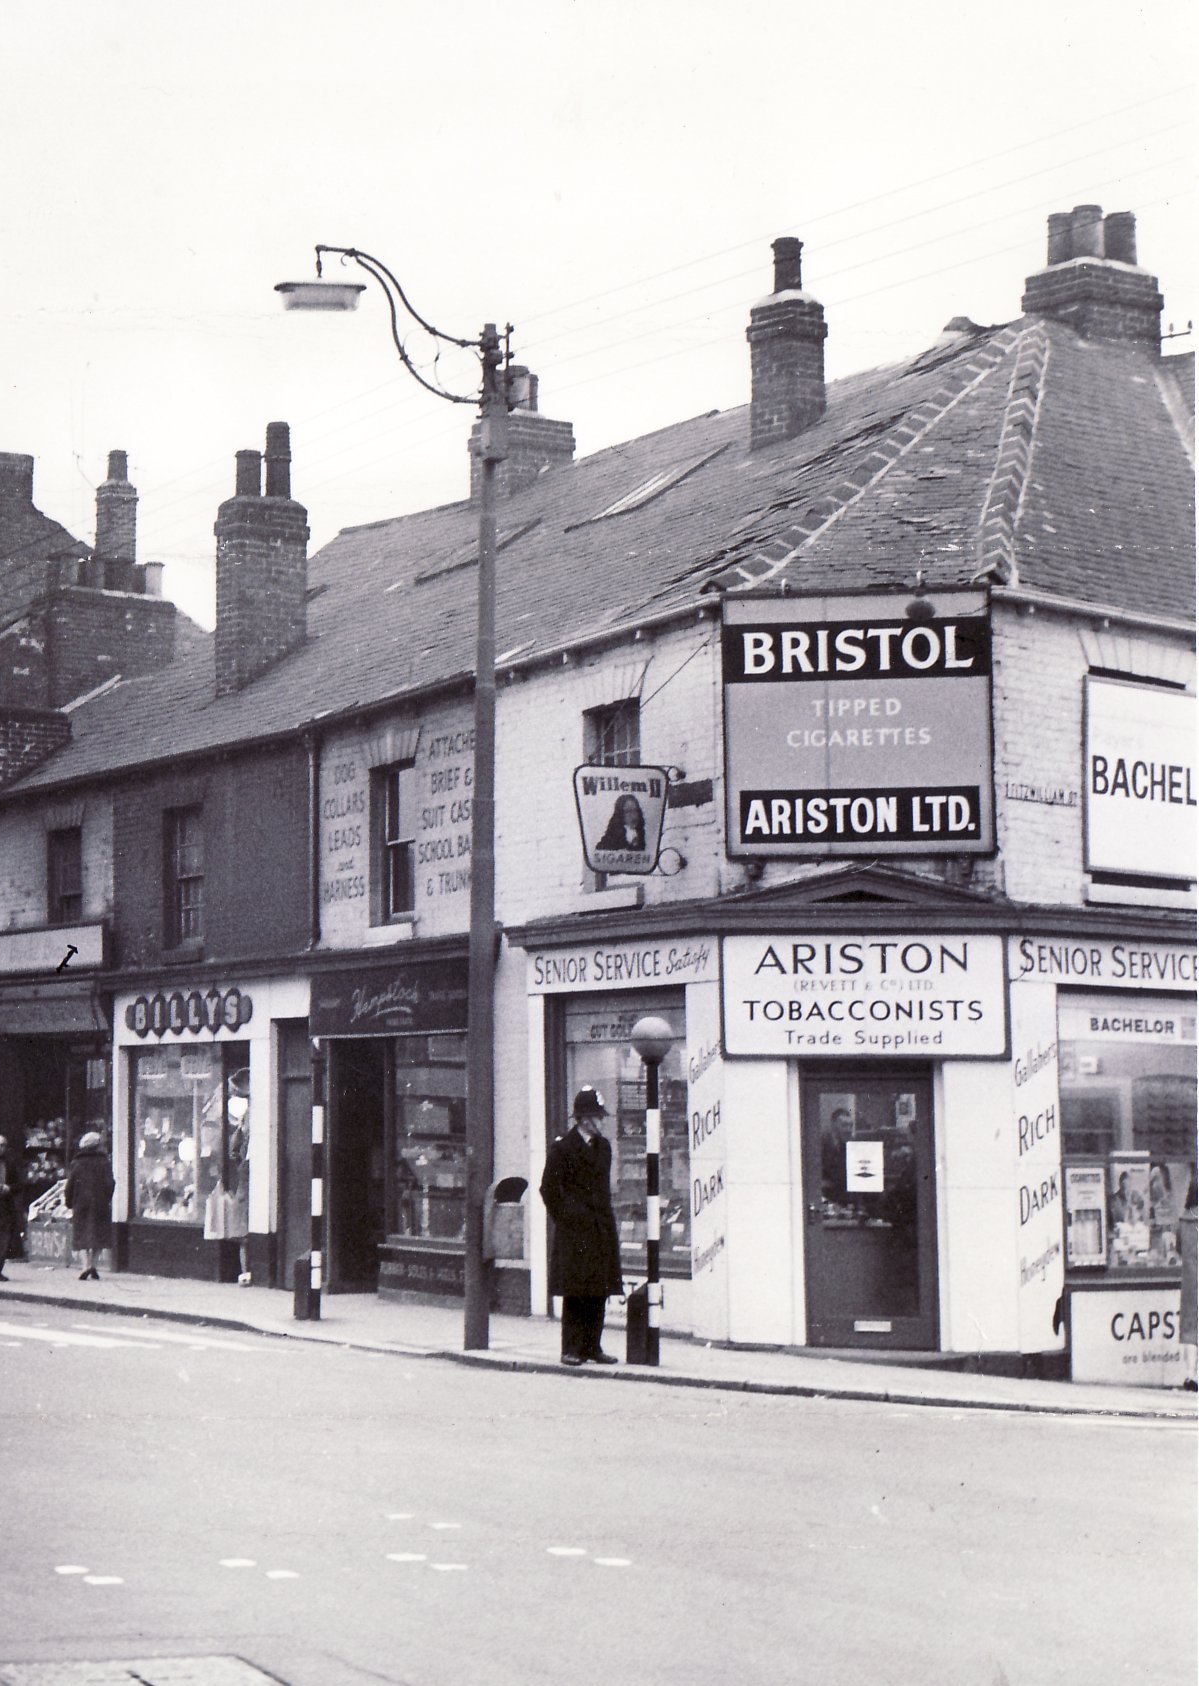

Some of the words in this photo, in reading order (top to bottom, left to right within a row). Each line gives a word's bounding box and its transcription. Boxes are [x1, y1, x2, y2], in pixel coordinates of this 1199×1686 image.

[742, 626, 975, 675] BRISTOL
[811, 697, 902, 718] TIPPED
[786, 727, 932, 748] CIGARETTES
[334, 762, 356, 786] DOG
[431, 768, 460, 795] BRIEF
[582, 776, 647, 796] Willem
[1091, 755, 1197, 807] BACHEL
[323, 790, 365, 820] COLLARS
[422, 805, 446, 831] SUIT
[450, 799, 471, 824] CAS
[744, 797, 898, 836] ARISTON
[911, 795, 976, 832] LTD.
[329, 825, 362, 852] LEADS
[418, 838, 455, 865] SCHOOL
[457, 834, 472, 857] BA
[323, 876, 366, 904] HARNESS
[438, 870, 472, 896] TRUN
[534, 956, 587, 985] SENIOR
[593, 951, 661, 981] SERVICE
[754, 942, 969, 975] ARISTON
[1019, 939, 1102, 977] SENIOR
[743, 1000, 984, 1022] TOBACCONISTS
[1089, 1017, 1175, 1034] BACHELOR
[784, 1029, 843, 1045] Trade
[854, 1030, 944, 1049] Supplied
[692, 1099, 721, 1151] RICH
[1018, 1103, 1056, 1157] RICH
[693, 1165, 724, 1218] DARK
[1018, 1171, 1059, 1227] DARK
[1110, 1311, 1180, 1342] CAPS
[1142, 1351, 1181, 1364] blended
